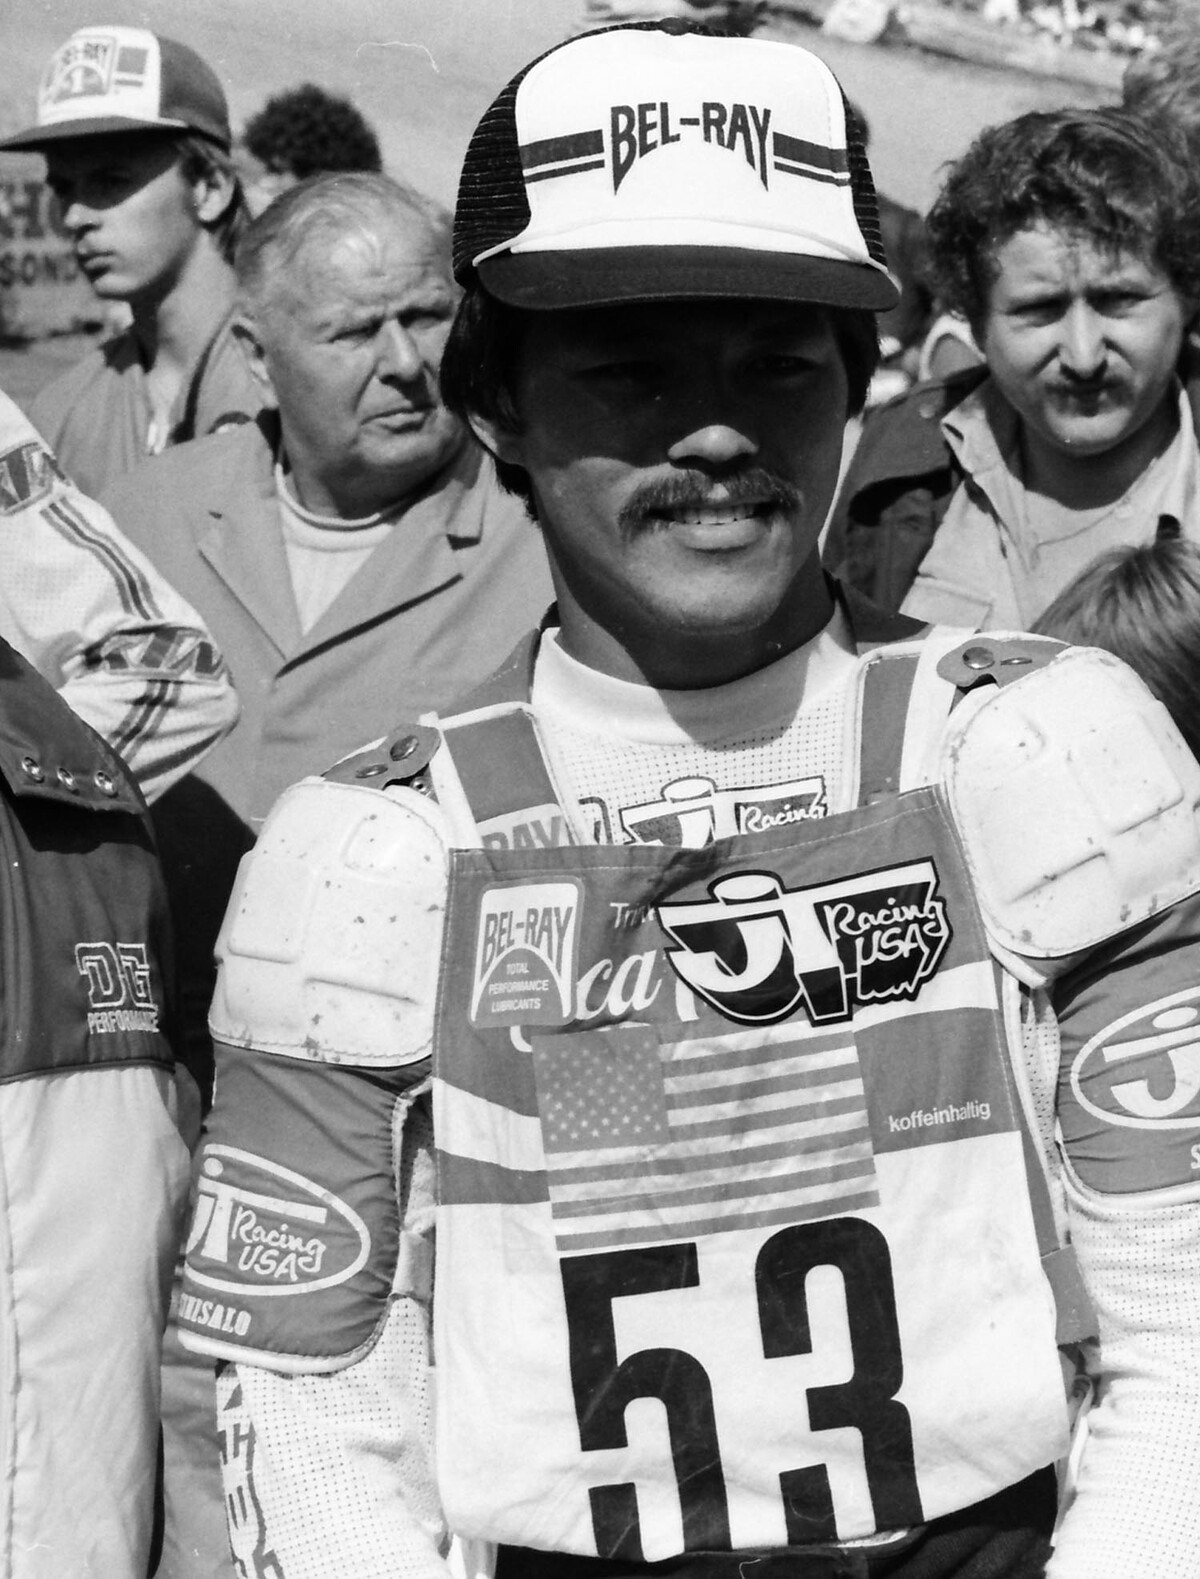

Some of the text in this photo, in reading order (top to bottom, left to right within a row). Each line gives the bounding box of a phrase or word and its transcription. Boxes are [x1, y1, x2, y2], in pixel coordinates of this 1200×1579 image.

[611, 102, 771, 195] BEL-RAY
[824, 898, 949, 939] Racing
[480, 907, 573, 982] BEL-RAY
[856, 924, 929, 965] USA
[488, 980, 549, 995] PERFORMANCE
[506, 963, 530, 975] TOTAL
[491, 998, 541, 1013] LUBRICANTS
[888, 1100, 991, 1132] koffeinhaltig
[232, 1205, 326, 1272] Racing
[238, 1244, 298, 1282] USA
[560, 1216, 925, 1561] 53
